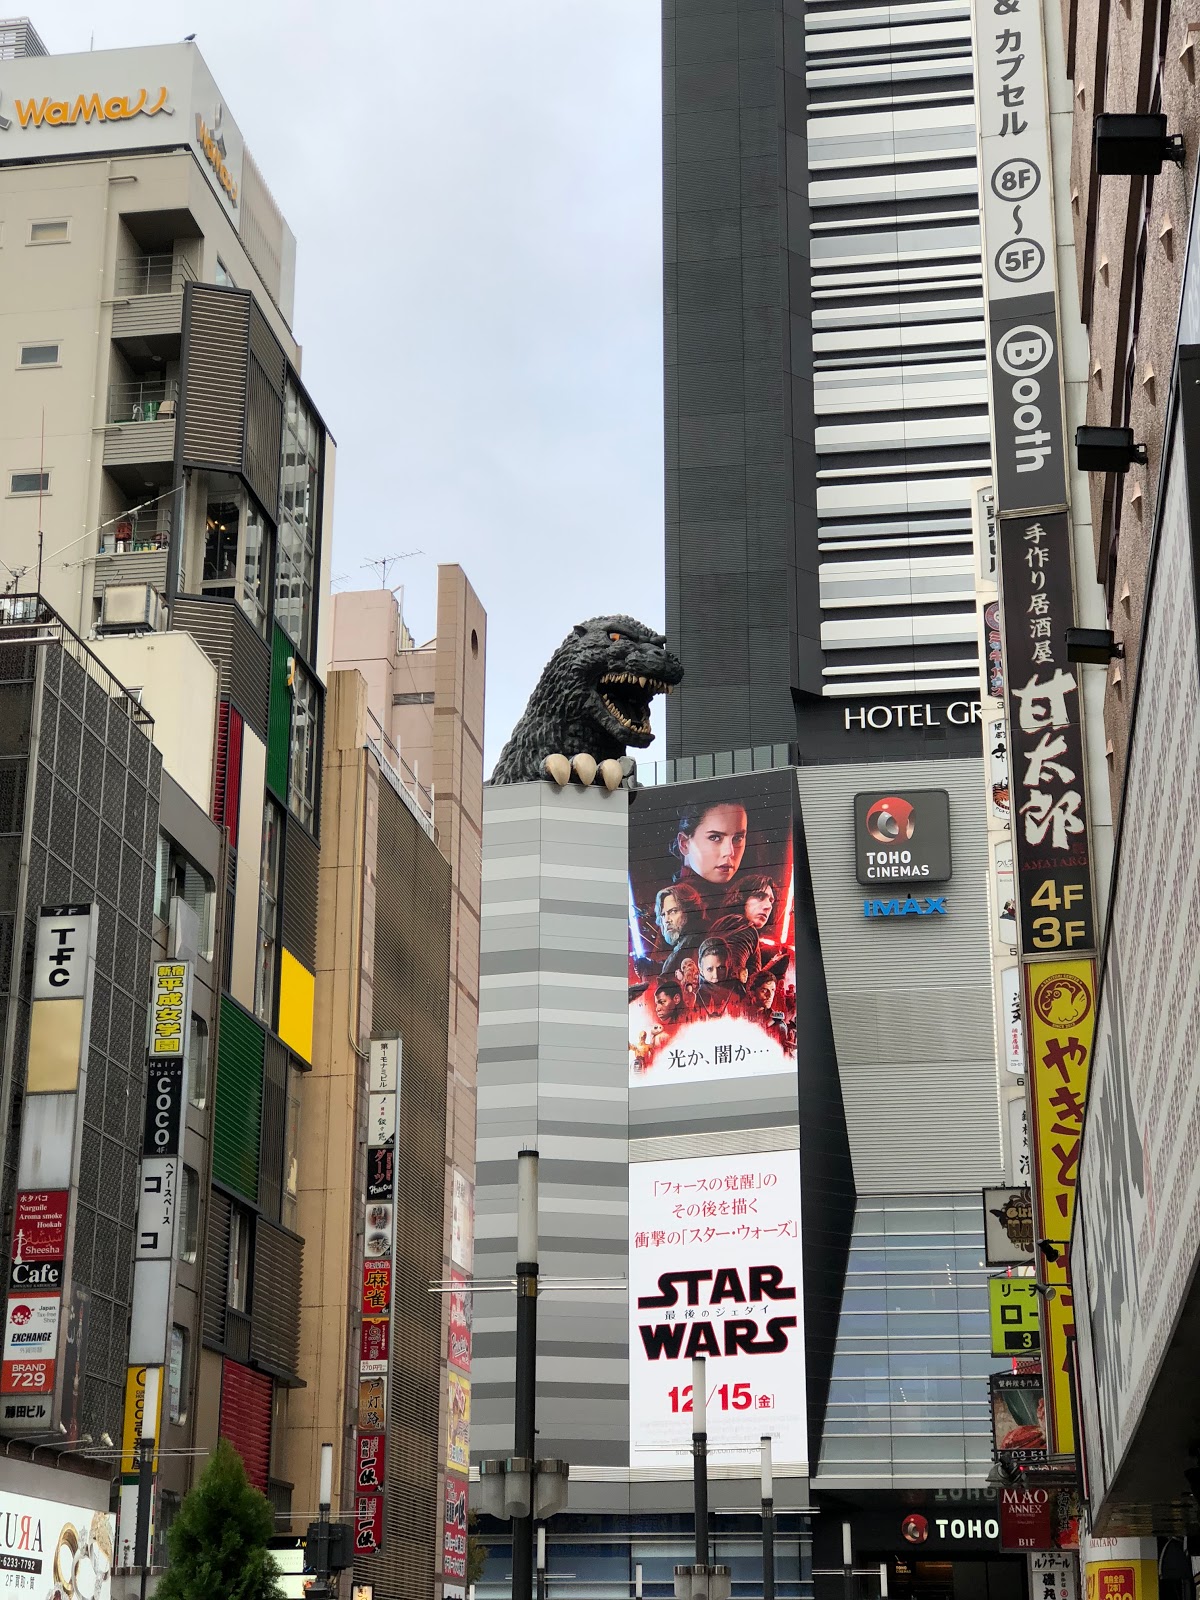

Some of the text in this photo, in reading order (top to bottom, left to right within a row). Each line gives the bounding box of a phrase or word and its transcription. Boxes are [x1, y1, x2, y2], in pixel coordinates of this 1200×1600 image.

[995, 29, 1028, 138] カプセル
[996, 324, 1053, 473] Booth
[1023, 522, 1054, 664] 手作り居酒屋
[844, 704, 940, 730] HOTEL
[1011, 668, 1085, 850] 甘太郎
[866, 850, 911, 865] TOHO
[867, 865, 930, 878] CINEMAS
[1031, 879, 1084, 911] 4F
[54, 908, 78, 916] 7F
[863, 897, 948, 917] IMAX
[1032, 916, 1086, 949] 3F
[48, 928, 76, 987] TFC
[157, 965, 186, 977] 新宿
[149, 1061, 175, 1069] Hair
[149, 1069, 182, 1077] Space
[374, 1149, 386, 1184] ダーツ
[162, 1162, 174, 1225] ヘアースペース
[653, 1172, 777, 1197] 「フォースの覚醒」の
[20, 1195, 48, 1203] 水タバコ
[672, 1198, 758, 1218] その後を描く
[37, 1221, 62, 1229] Hookah
[42, 1212, 63, 1220] smoke
[634, 1220, 798, 1248] 衝撃の「スター・ウォーズ」
[25, 1246, 60, 1254] Sheesha
[12, 1264, 59, 1284] Cafe
[364, 1270, 389, 1308] 麻雀
[638, 1265, 796, 1309] STAR
[664, 1304, 769, 1320] 最後のジェダイ
[11, 1332, 52, 1343] EXCHANGE
[638, 1316, 797, 1361] WARS
[12, 1363, 47, 1372] BRAND
[11, 1372, 46, 1387] 729
[359, 1457, 378, 1487] 一休
[1008, 1504, 1042, 1513] ANNEX
[356, 1520, 376, 1548] 一休
[936, 1519, 999, 1539] TOHO
[1018, 1539, 1036, 1547] B1F
[1034, 1558, 1070, 1569] ルノアール
